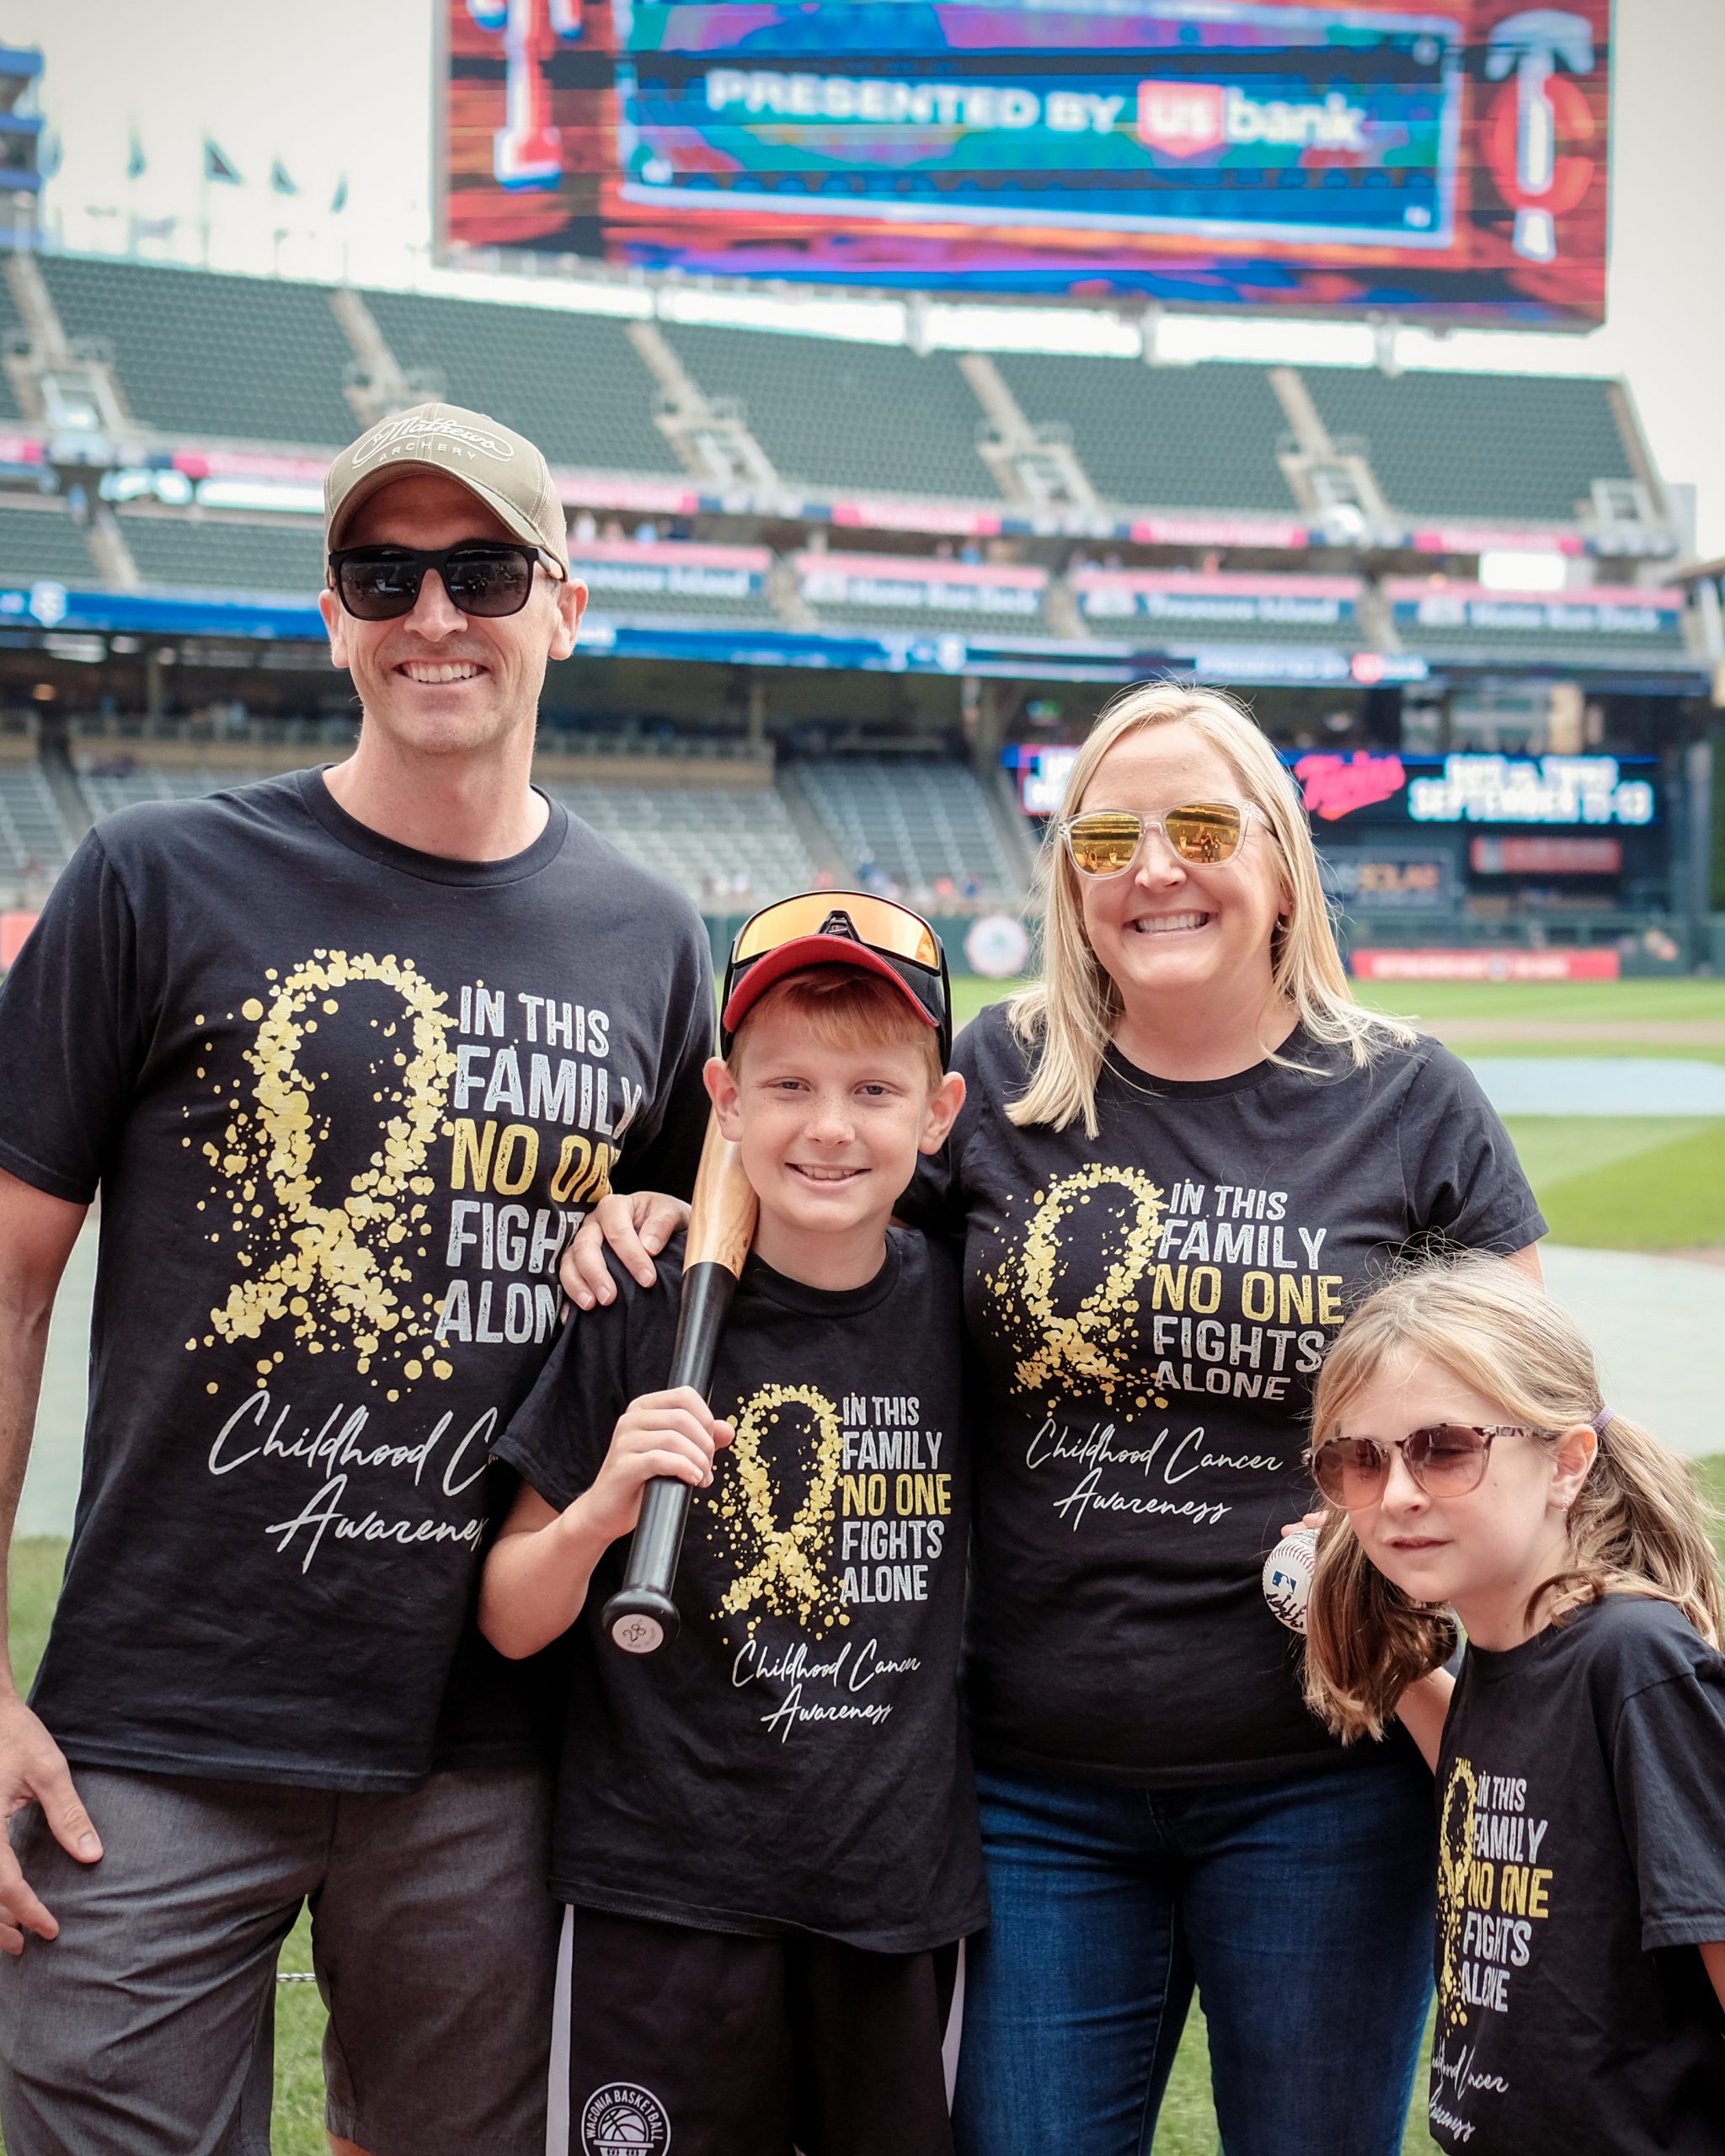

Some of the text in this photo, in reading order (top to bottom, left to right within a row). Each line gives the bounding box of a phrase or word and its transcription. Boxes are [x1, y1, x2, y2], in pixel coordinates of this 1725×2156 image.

[707, 68, 1039, 129] PRESENTED
[1046, 90, 1124, 133] BY
[1224, 86, 1371, 152] bank
[379, 440, 477, 462] ARCHERY
[460, 985, 609, 1058] IN THIS
[454, 1044, 642, 1139] FAMILY
[451, 1118, 621, 1203] NO ON
[1168, 1183, 1288, 1220] IN THIS
[446, 1200, 585, 1274] FIGHT
[1158, 1219, 1327, 1270] FAMILY
[434, 1279, 563, 1344] ALON
[1152, 1264, 1346, 1326] NO ONE
[1153, 1315, 1326, 1373] FIGHTS
[1154, 1361, 1291, 1401] ALONE
[208, 1389, 455, 1486] Childhood
[843, 1396, 919, 1426] IN THIS
[842, 1431, 943, 1470] FAMILY
[1025, 1418, 1284, 1485] Childhood Cancer
[843, 1473, 952, 1516] NO ONE
[1053, 1467, 1233, 1532] Awareness
[842, 1520, 945, 1561] FIGHTS
[841, 1565, 928, 1603] ALONE
[622, 1623, 647, 1643] 28
[731, 1639, 852, 1688] Childhood
[760, 1683, 894, 1743] Awareness
[1477, 1774, 1527, 1812] IN THIS
[1472, 1813, 1548, 1864] FAMILY
[1467, 1860, 1553, 1919] NO ONE
[586, 2089, 664, 2142] WACONIA BASKETBALL
